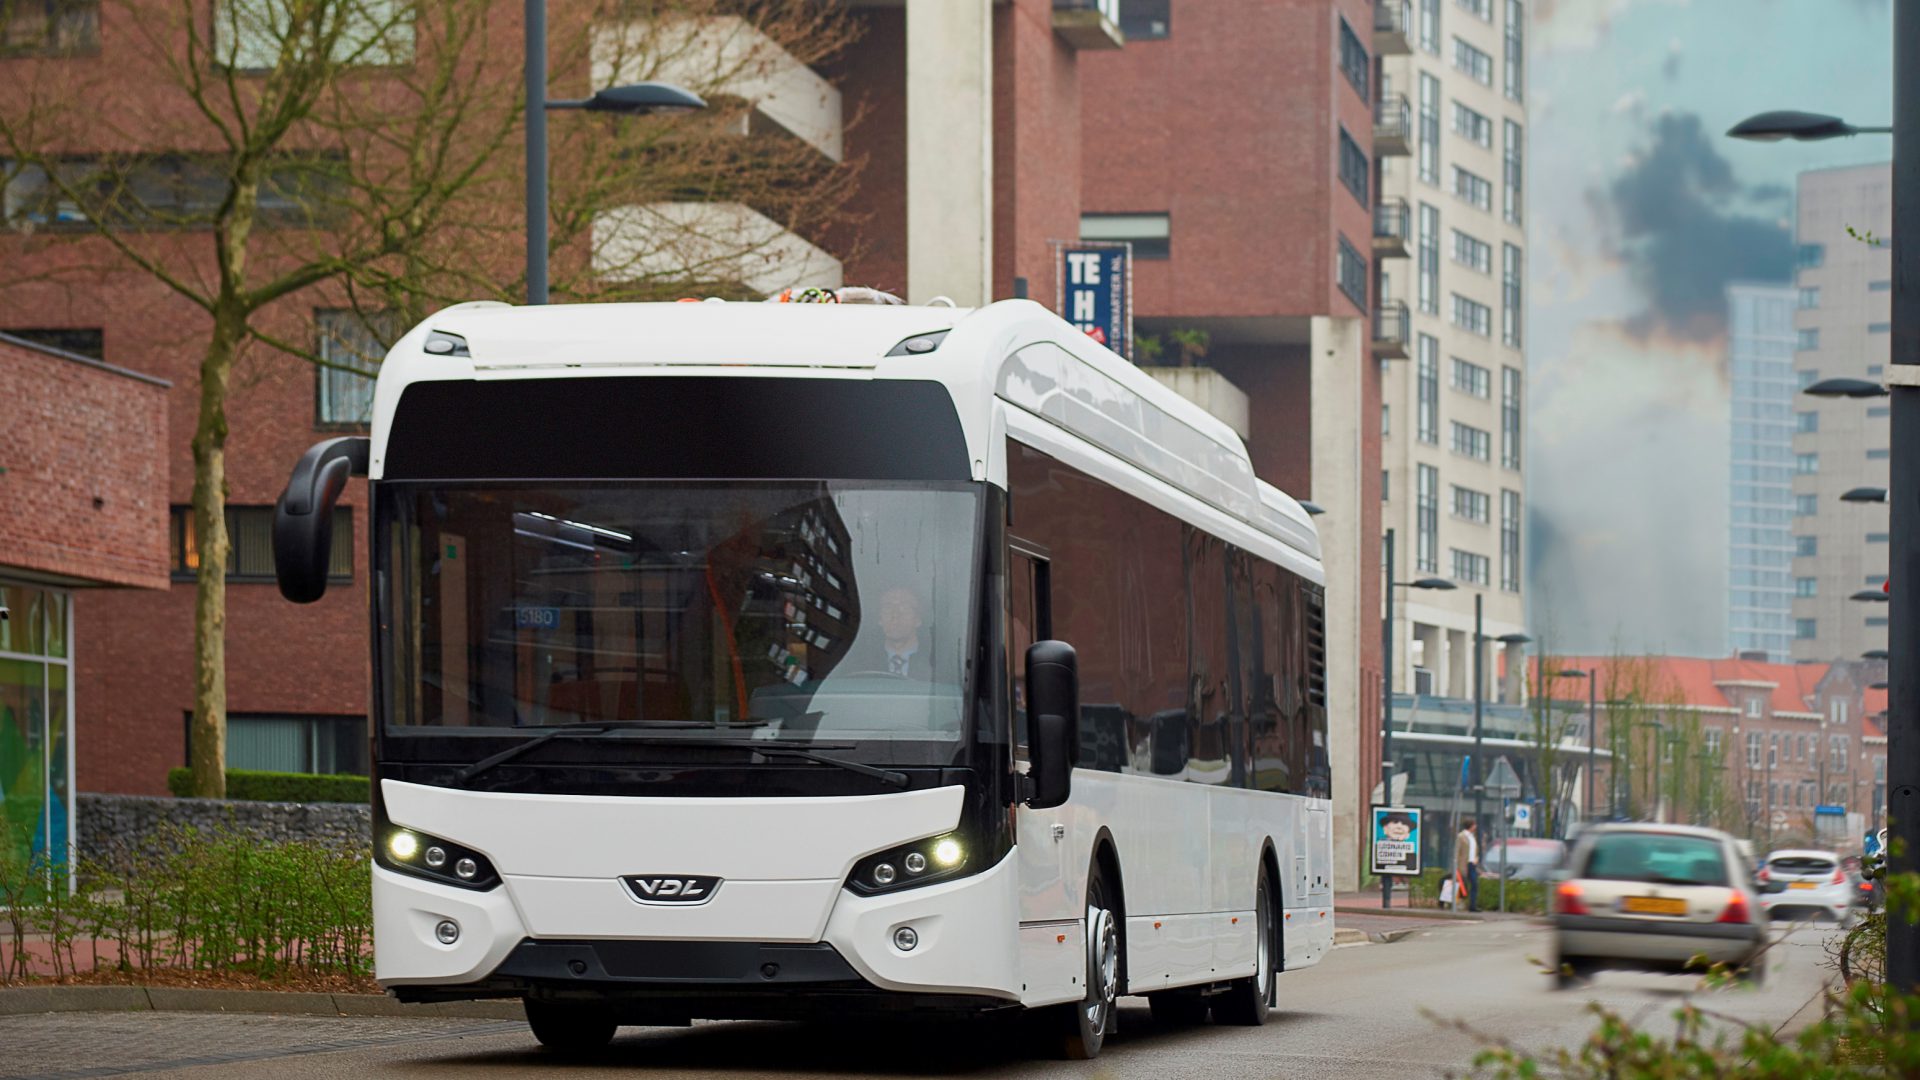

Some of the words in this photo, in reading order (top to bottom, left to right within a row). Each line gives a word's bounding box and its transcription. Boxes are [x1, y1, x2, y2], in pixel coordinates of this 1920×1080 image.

[1068, 253, 1101, 285] TE
[1074, 290, 1095, 321] H
[635, 879, 704, 896] VDL
